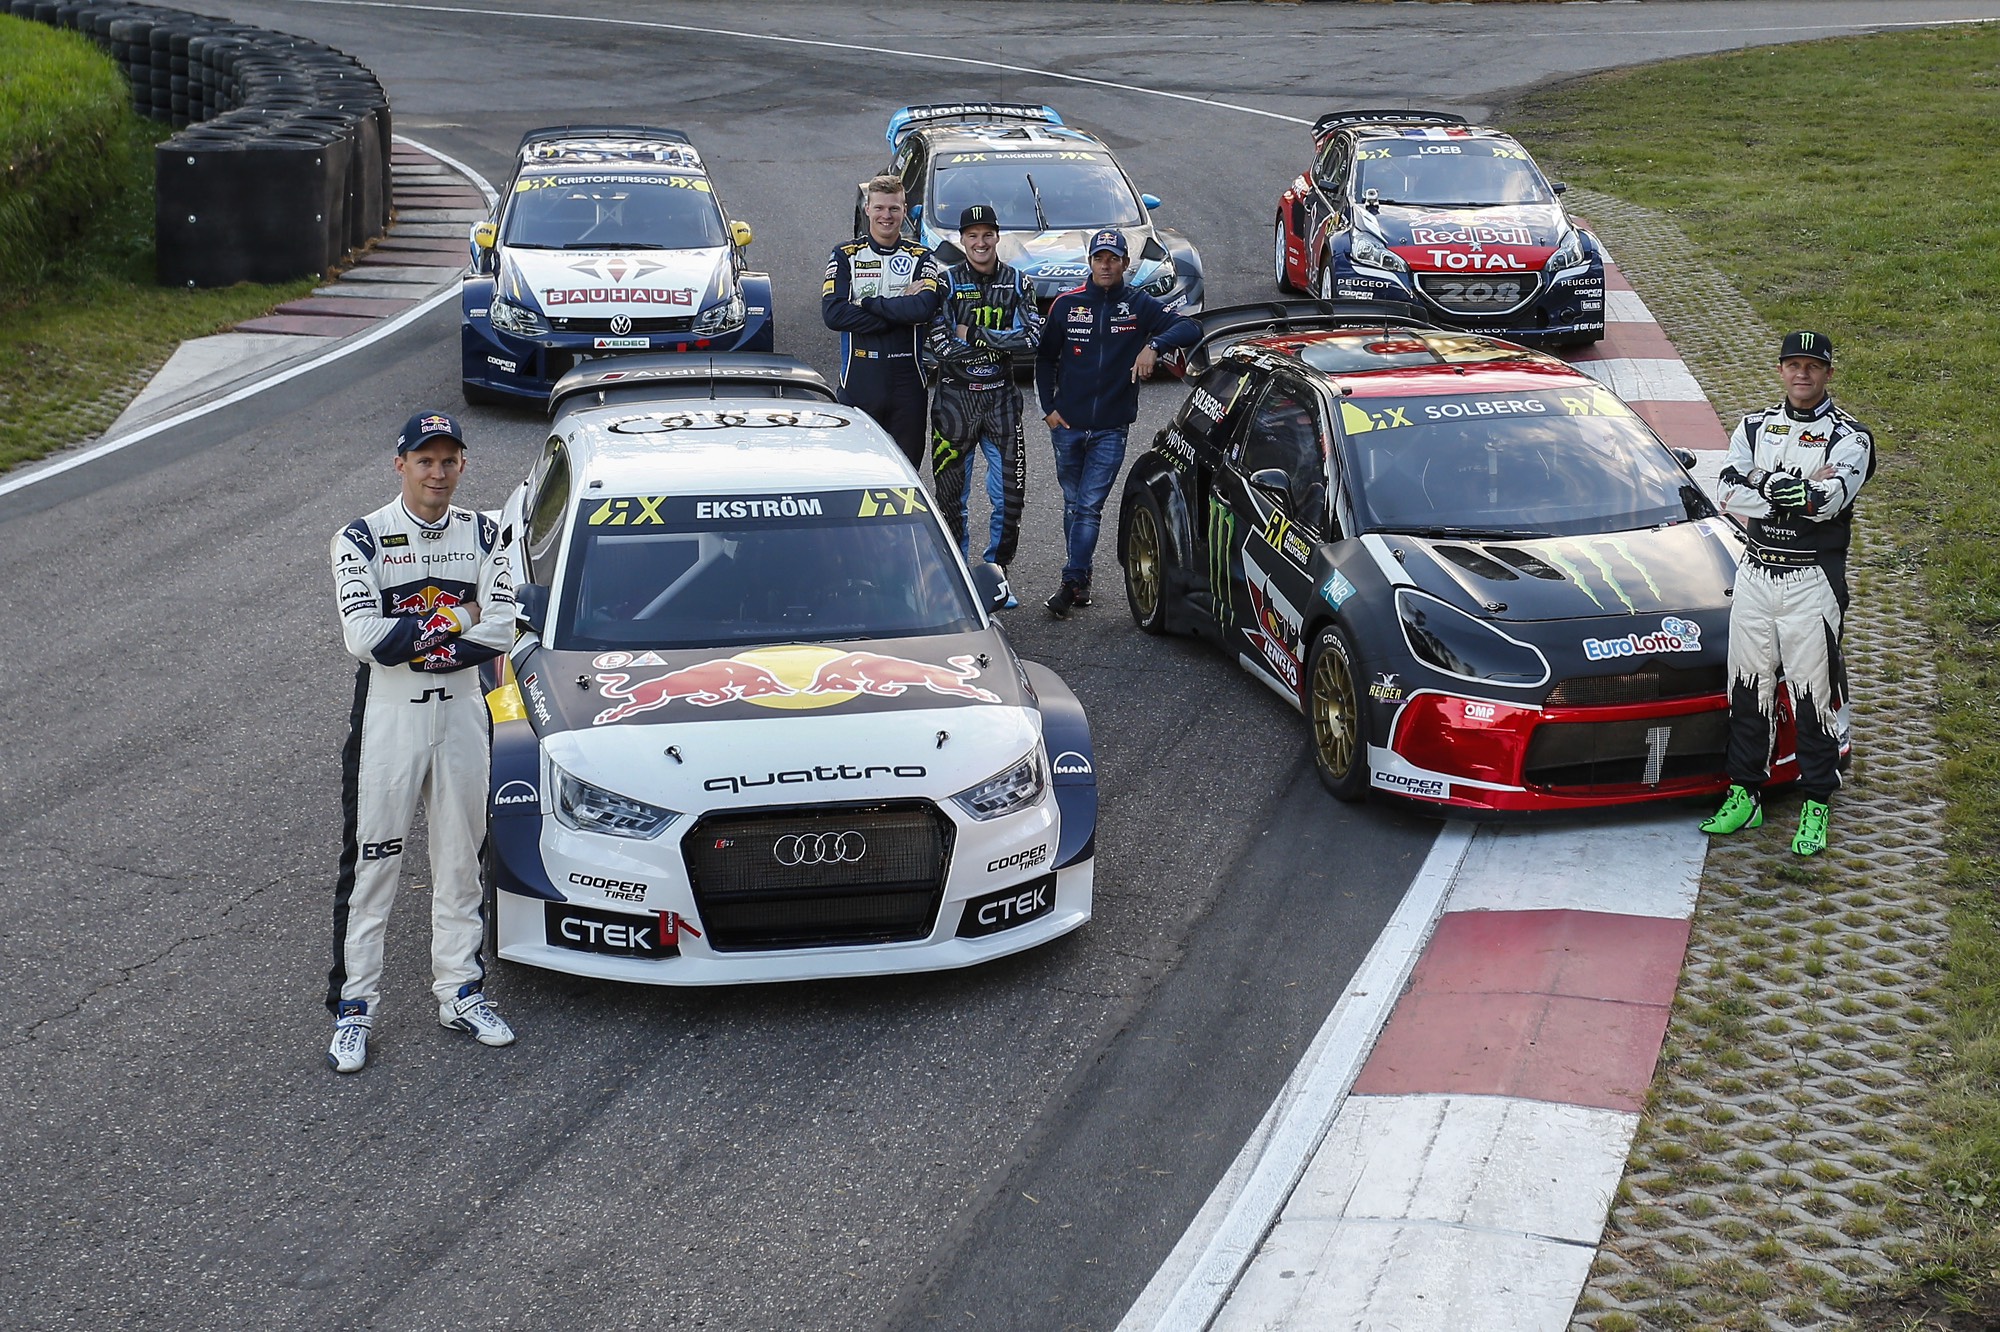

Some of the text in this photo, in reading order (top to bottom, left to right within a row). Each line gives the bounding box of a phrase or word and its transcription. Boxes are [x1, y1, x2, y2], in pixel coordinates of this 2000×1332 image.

[1418, 146, 1462, 155] LOEB
[558, 175, 668, 186] KRISTOFFERSSON
[1427, 250, 1527, 269] TOTAL
[1037, 264, 1089, 277] Ford
[1338, 279, 1391, 289] PEUGEOT
[1560, 277, 1602, 287] PEUGEOT
[549, 290, 690, 304] BAUHAUS
[1338, 290, 1374, 298] COOPER
[1439, 282, 1520, 303] 208
[487, 355, 517, 370] COOPER
[634, 368, 782, 378] Audi Sport
[1192, 386, 1223, 421] SOLBERG
[1424, 399, 1546, 419] SOLBERG
[1160, 448, 1188, 473] ENERGY
[696, 495, 823, 519] EKSTRÖM
[383, 552, 475, 566] Audi quattro
[342, 591, 369, 602] MAN
[1369, 684, 1402, 700] REIGER
[528, 680, 552, 726] Audi Sport
[1464, 704, 1495, 719] OMP
[1641, 726, 1671, 785] 1
[1056, 765, 1089, 774] MAN
[703, 765, 927, 794] quattro
[1375, 771, 1443, 790] COOPER
[497, 794, 535, 804] MAN
[1406, 786, 1441, 796] TIRES
[362, 838, 403, 861] EKS
[986, 843, 1047, 873] COOPER
[1018, 854, 1046, 871] TIRES
[568, 873, 648, 894] COOPER
[604, 889, 646, 903] TIRES
[978, 884, 1047, 926] CTEK
[560, 916, 653, 951] CTEK
